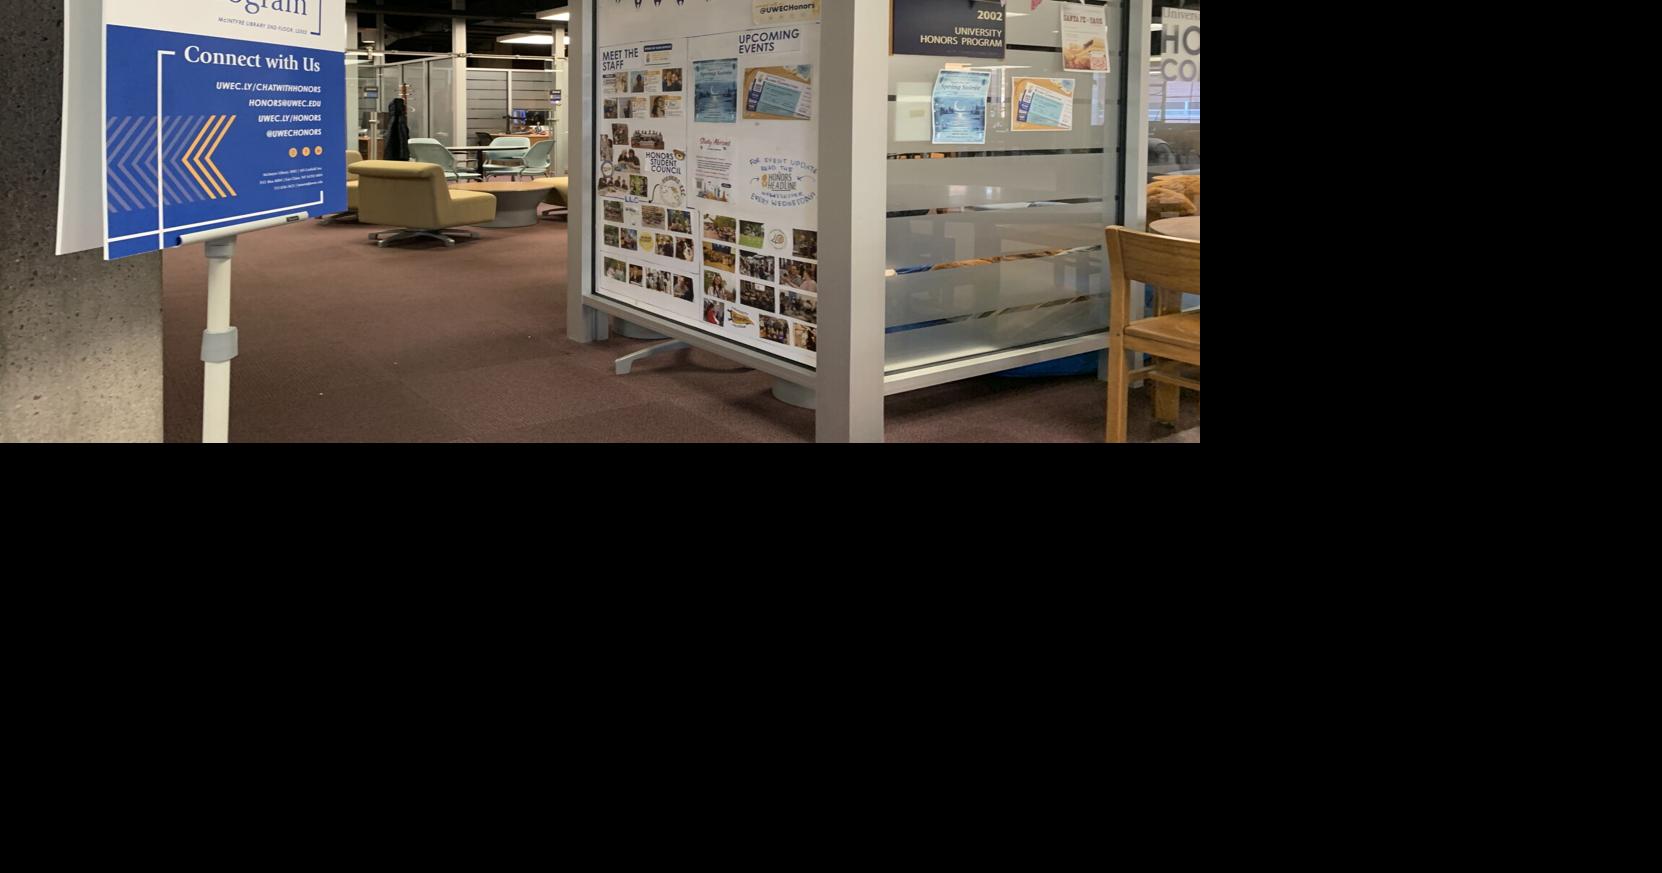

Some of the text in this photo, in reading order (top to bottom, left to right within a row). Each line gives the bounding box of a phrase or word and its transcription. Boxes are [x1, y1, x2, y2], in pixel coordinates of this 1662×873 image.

[977, 10, 1003, 21] 2002
[738, 28, 800, 44] UPCOMING
[954, 27, 1002, 37] UNIVERSITY
[920, 35, 1003, 47] HONORS PROGRAM
[738, 42, 775, 54] EVENTS
[184, 46, 321, 72] Connect with Us
[602, 50, 622, 61] MEET
[624, 48, 639, 59] THE
[602, 60, 624, 71] STAFF
[216, 82, 321, 93] UWEC.LY/CHATWITHHONORS
[248, 99, 322, 107] HONORS@UWEC.EDU
[258, 114, 322, 123] UWEC.LY/HONORS
[266, 128, 322, 138] @UWECHONORS
[645, 152, 674, 160] HONORS
[650, 158, 677, 167] STUDENT
[651, 165, 681, 175] COUNCIL
